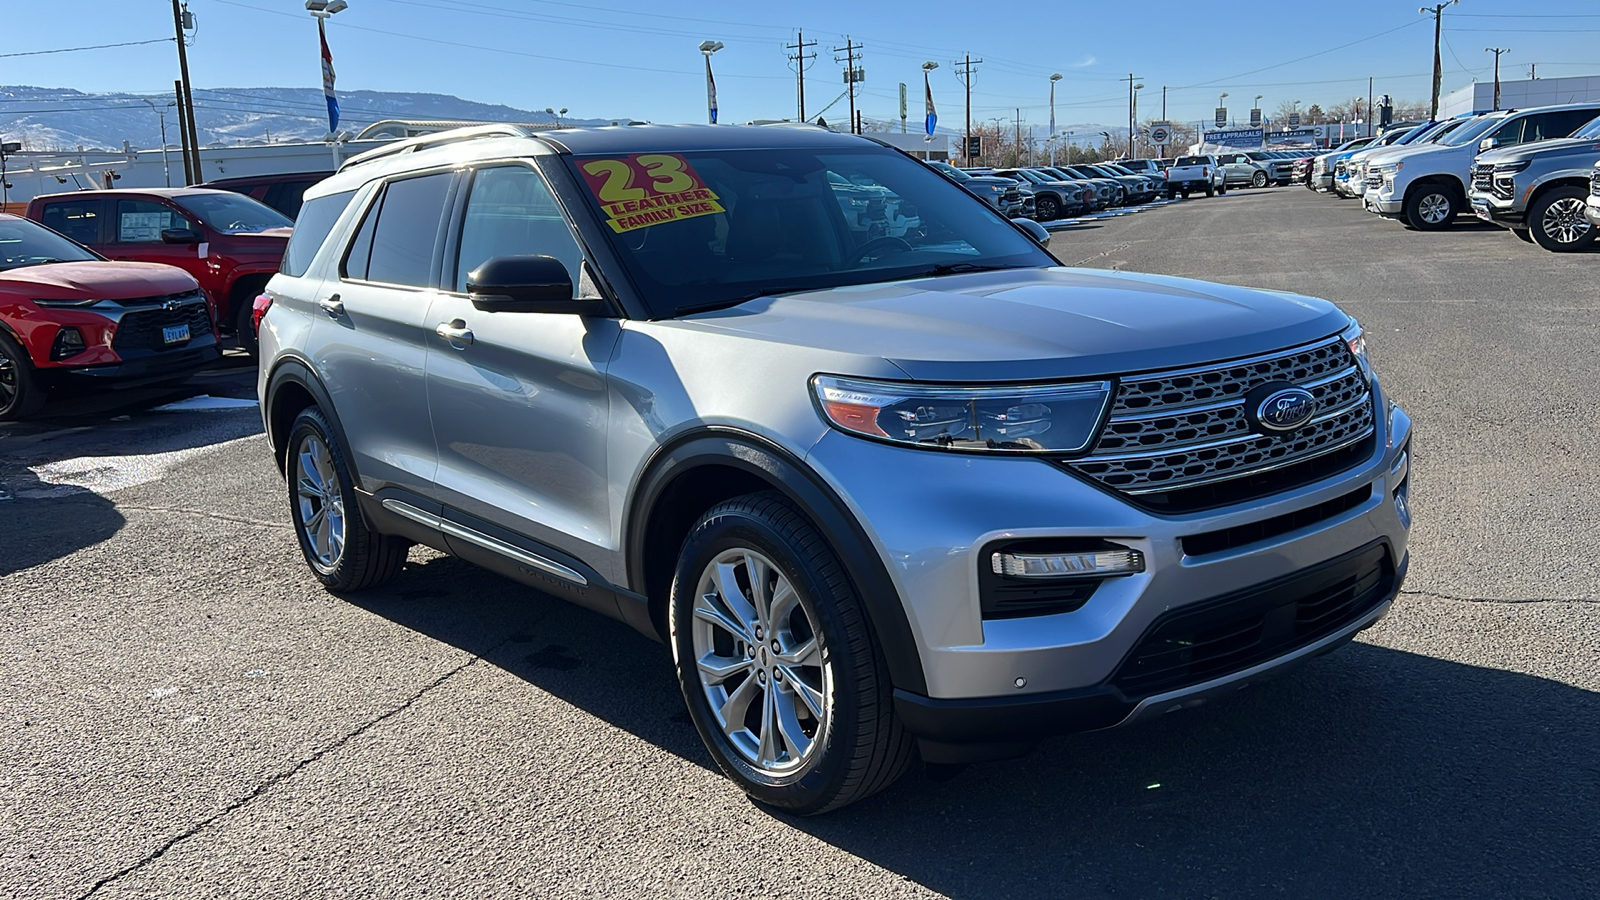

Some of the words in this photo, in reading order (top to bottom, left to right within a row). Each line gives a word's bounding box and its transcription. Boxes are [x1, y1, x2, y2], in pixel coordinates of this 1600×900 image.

[1222, 131, 1262, 139] APPRAISALS!
[582, 154, 697, 202] 23
[610, 189, 713, 216] LEATHER
[617, 207, 677, 230] FAMILY
[677, 202, 716, 216] SIZE
[1275, 397, 1306, 422] Ford
